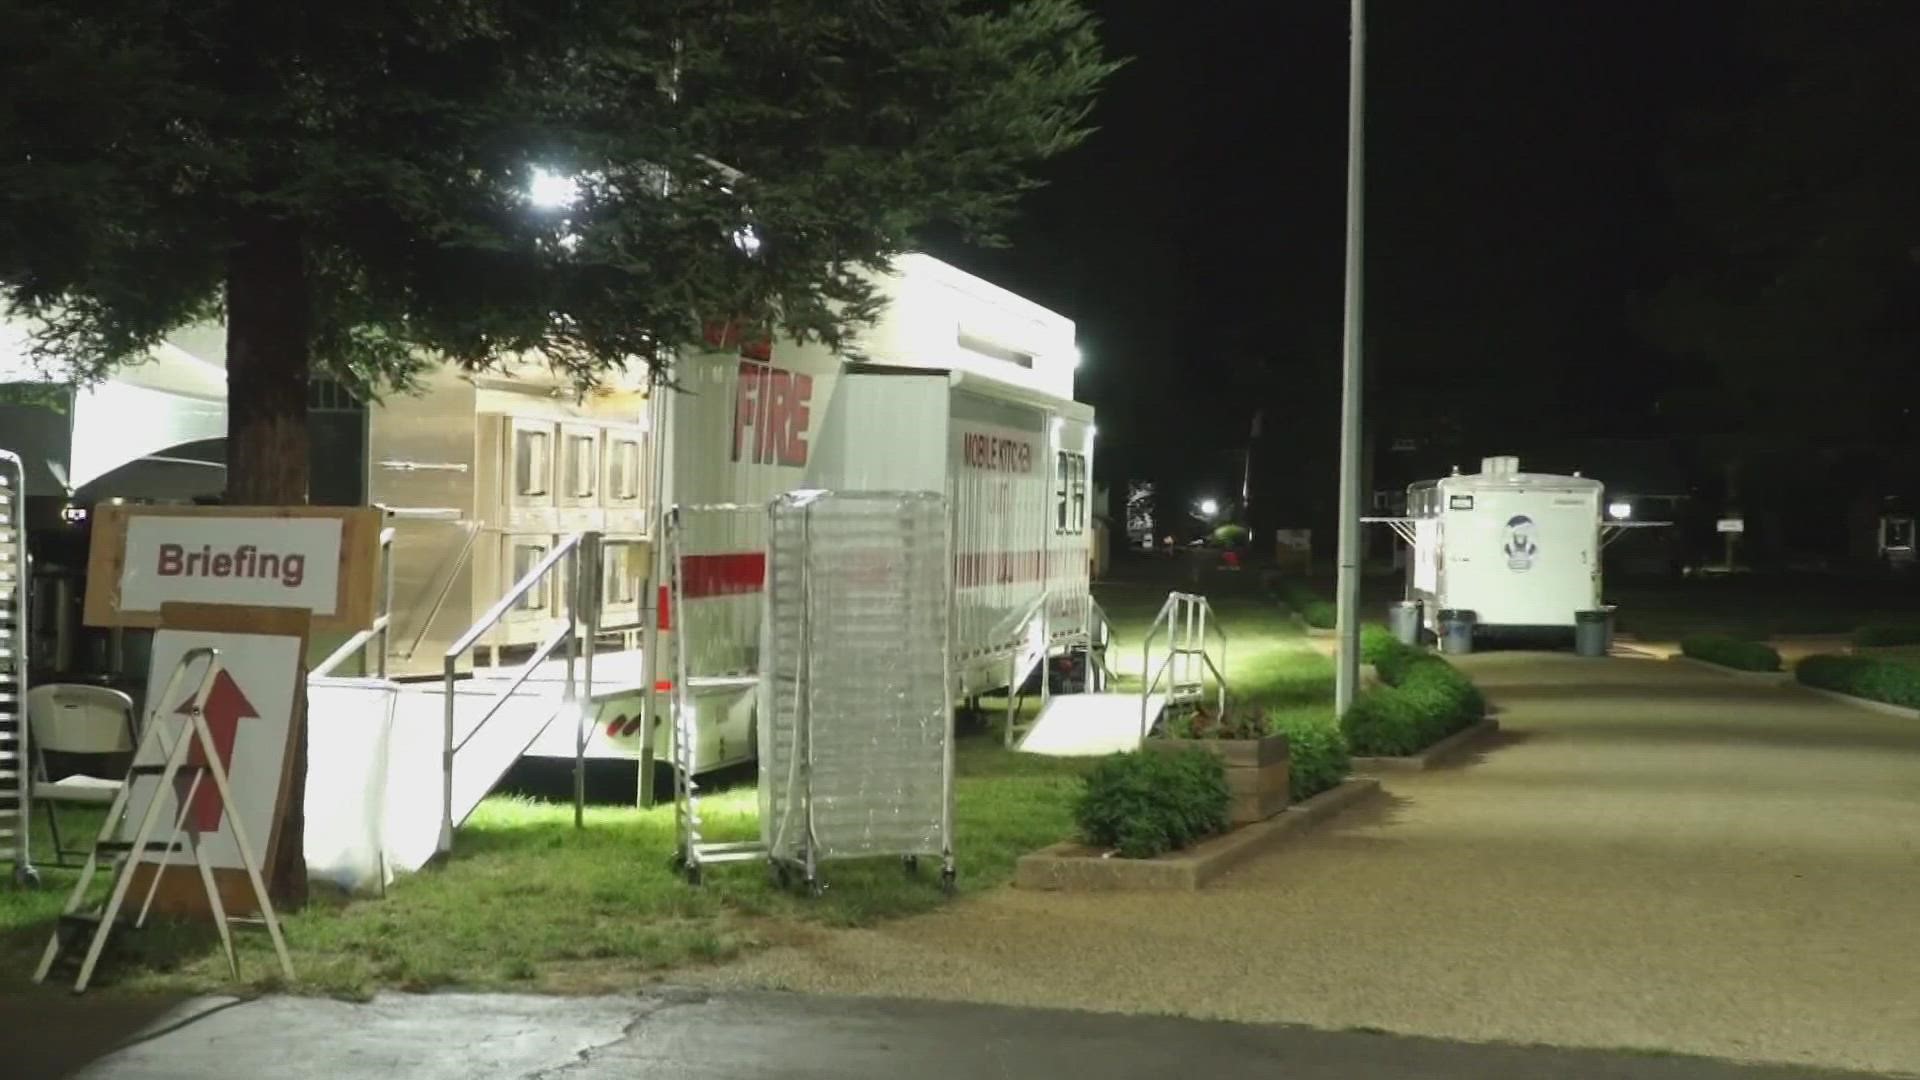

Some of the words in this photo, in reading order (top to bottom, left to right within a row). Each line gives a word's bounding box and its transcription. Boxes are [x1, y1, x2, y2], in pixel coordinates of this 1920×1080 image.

[731, 361, 813, 467] FIRE
[964, 432, 996, 470] MOBILE
[157, 543, 304, 587] Briefing
